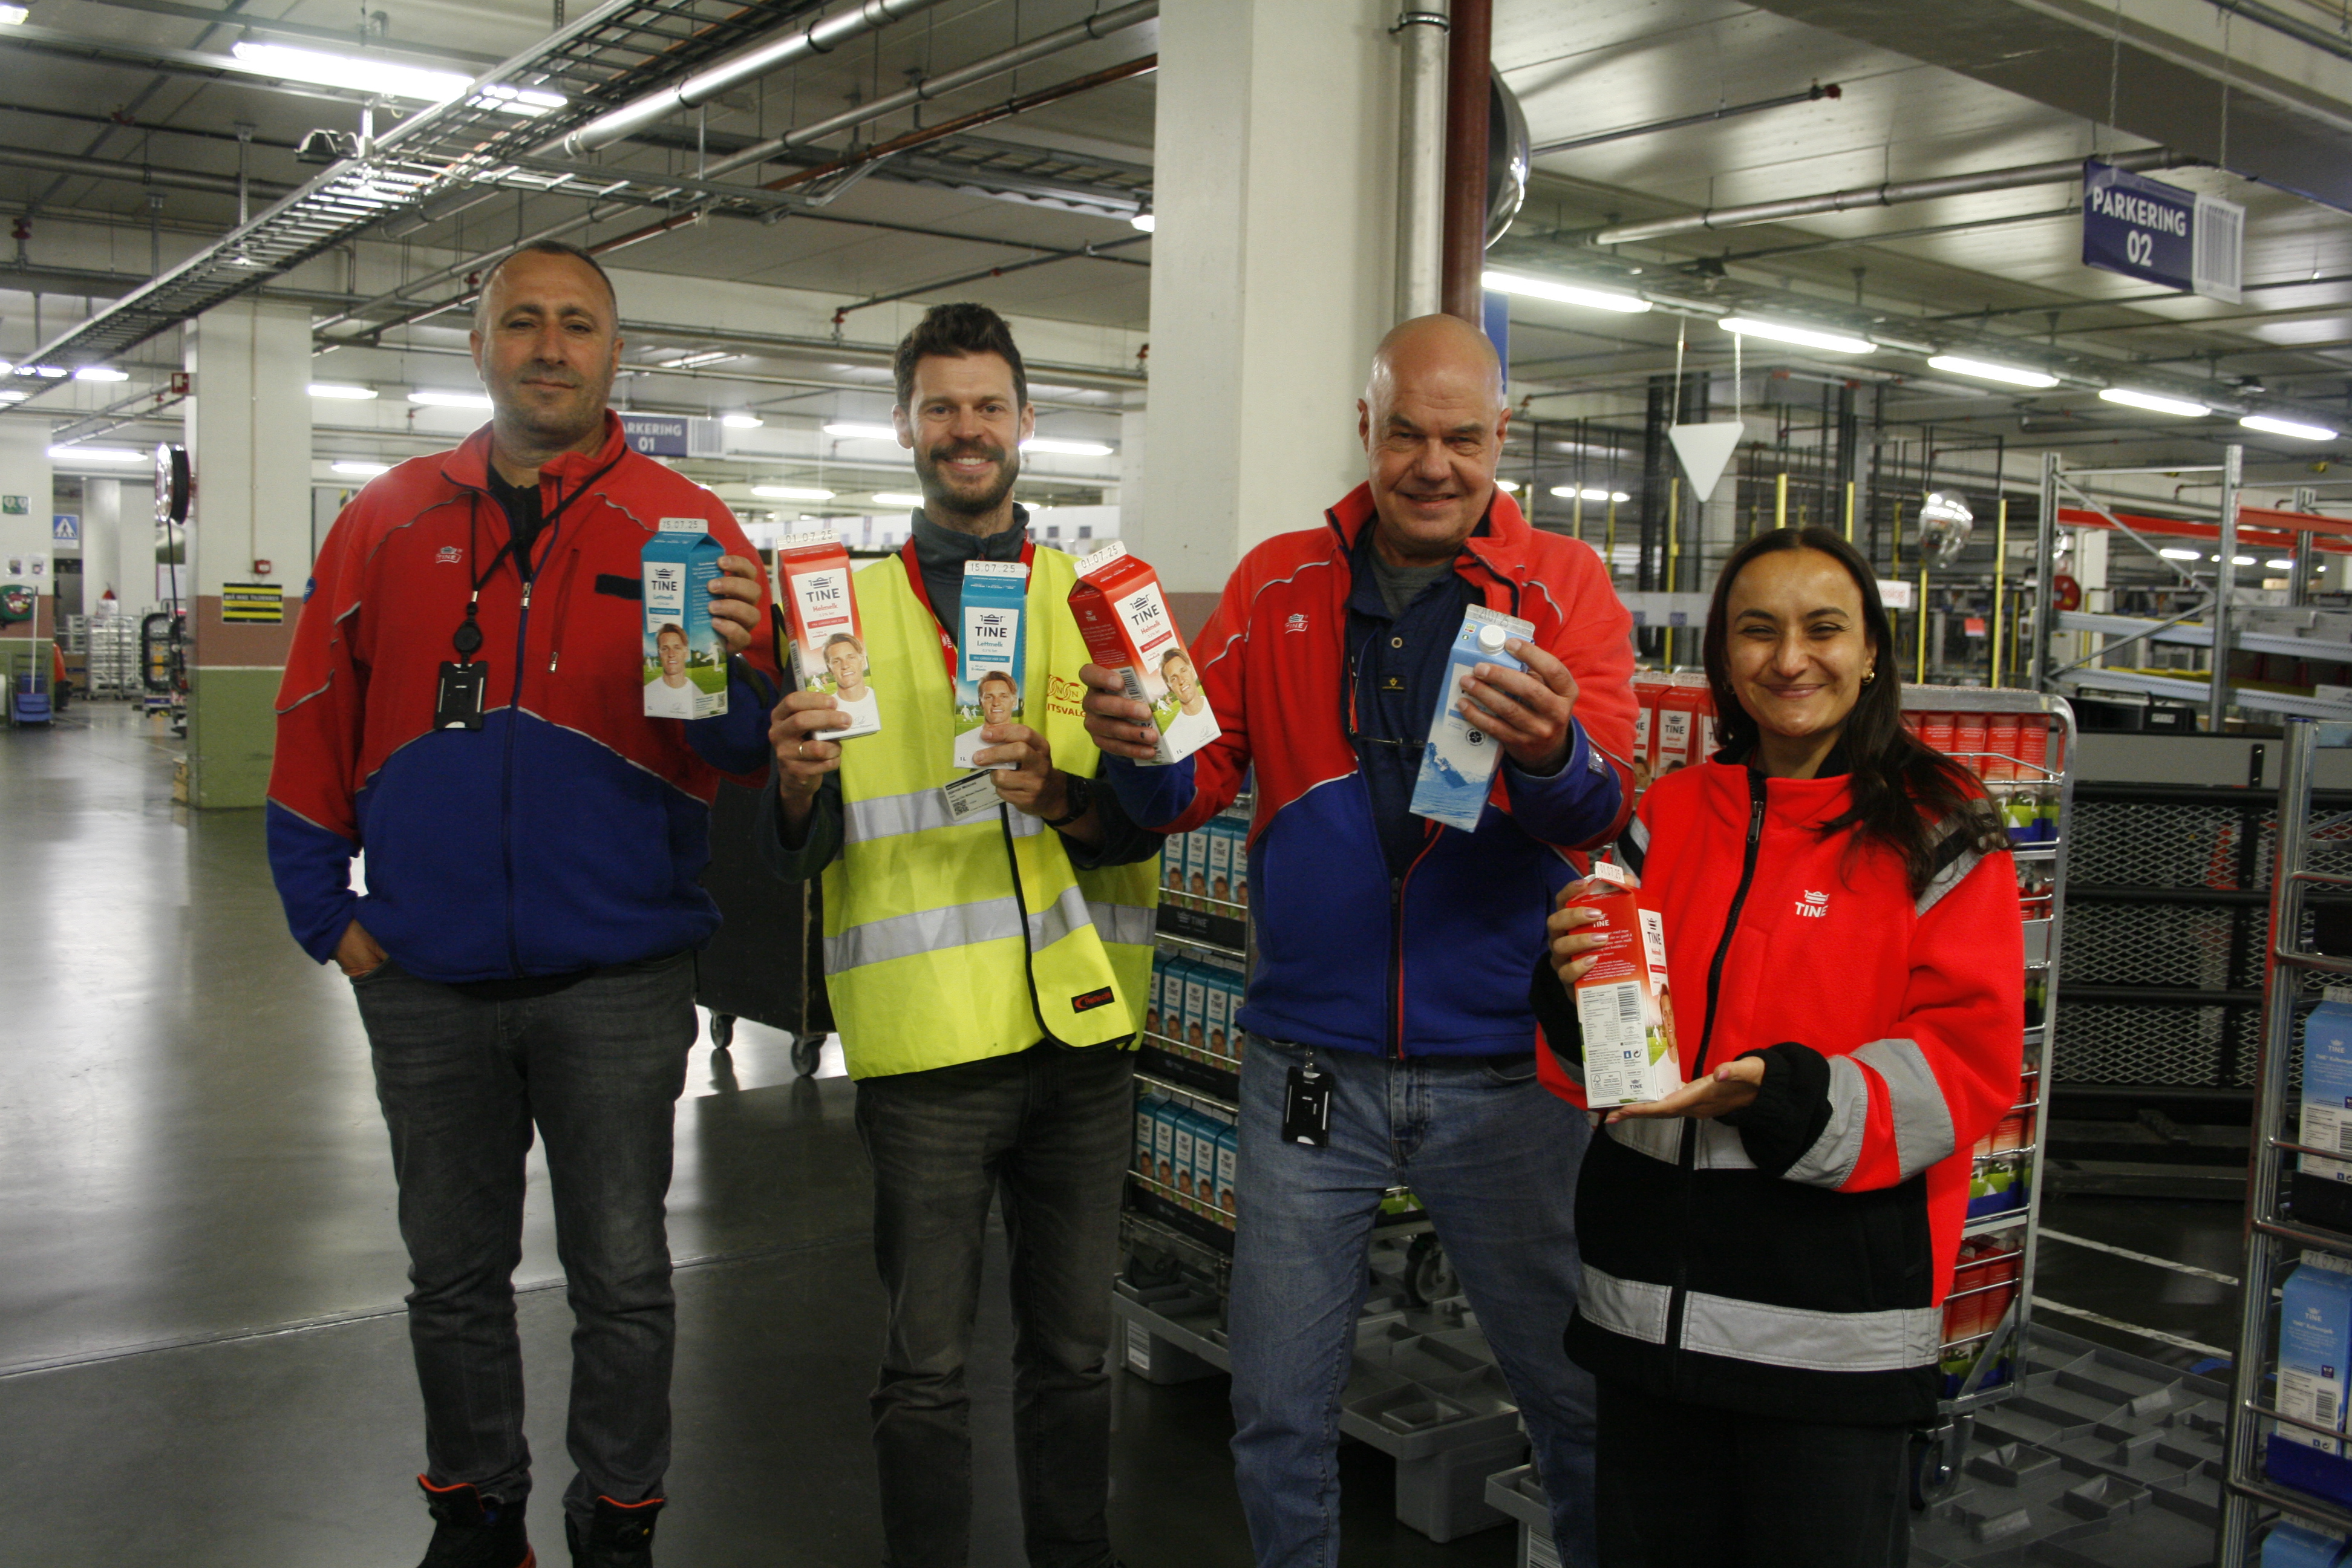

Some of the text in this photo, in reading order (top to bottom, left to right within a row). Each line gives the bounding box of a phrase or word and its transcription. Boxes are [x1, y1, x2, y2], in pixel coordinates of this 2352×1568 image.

[2092, 185, 2186, 237] PARKERING
[2126, 230, 2153, 267] 02
[624, 422, 682, 437] RKERING
[638, 436, 656, 452] 01
[786, 529, 834, 543] 01.07.25
[1080, 544, 1119, 569] 01.07.25
[971, 563, 1016, 573] 15.07.25
[651, 580, 678, 591] TINE
[806, 588, 840, 603] TINE
[812, 603, 838, 612] Helmelk
[1131, 604, 1160, 626] TINE
[975, 626, 1007, 638] TINE
[1140, 620, 1161, 635] Helmelk
[1047, 704, 1086, 717] ITSVALG
[1665, 725, 1685, 734] TINE
[1214, 847, 1226, 857] TINE
[1795, 901, 1829, 918] TINE
[1647, 931, 1662, 945] TINE
[2328, 1045, 2345, 1054] TINE
[1221, 1159, 1232, 1169] TINE
[2307, 1252, 2352, 1275] 21.07.2
[2305, 1312, 2322, 1322] TINE
